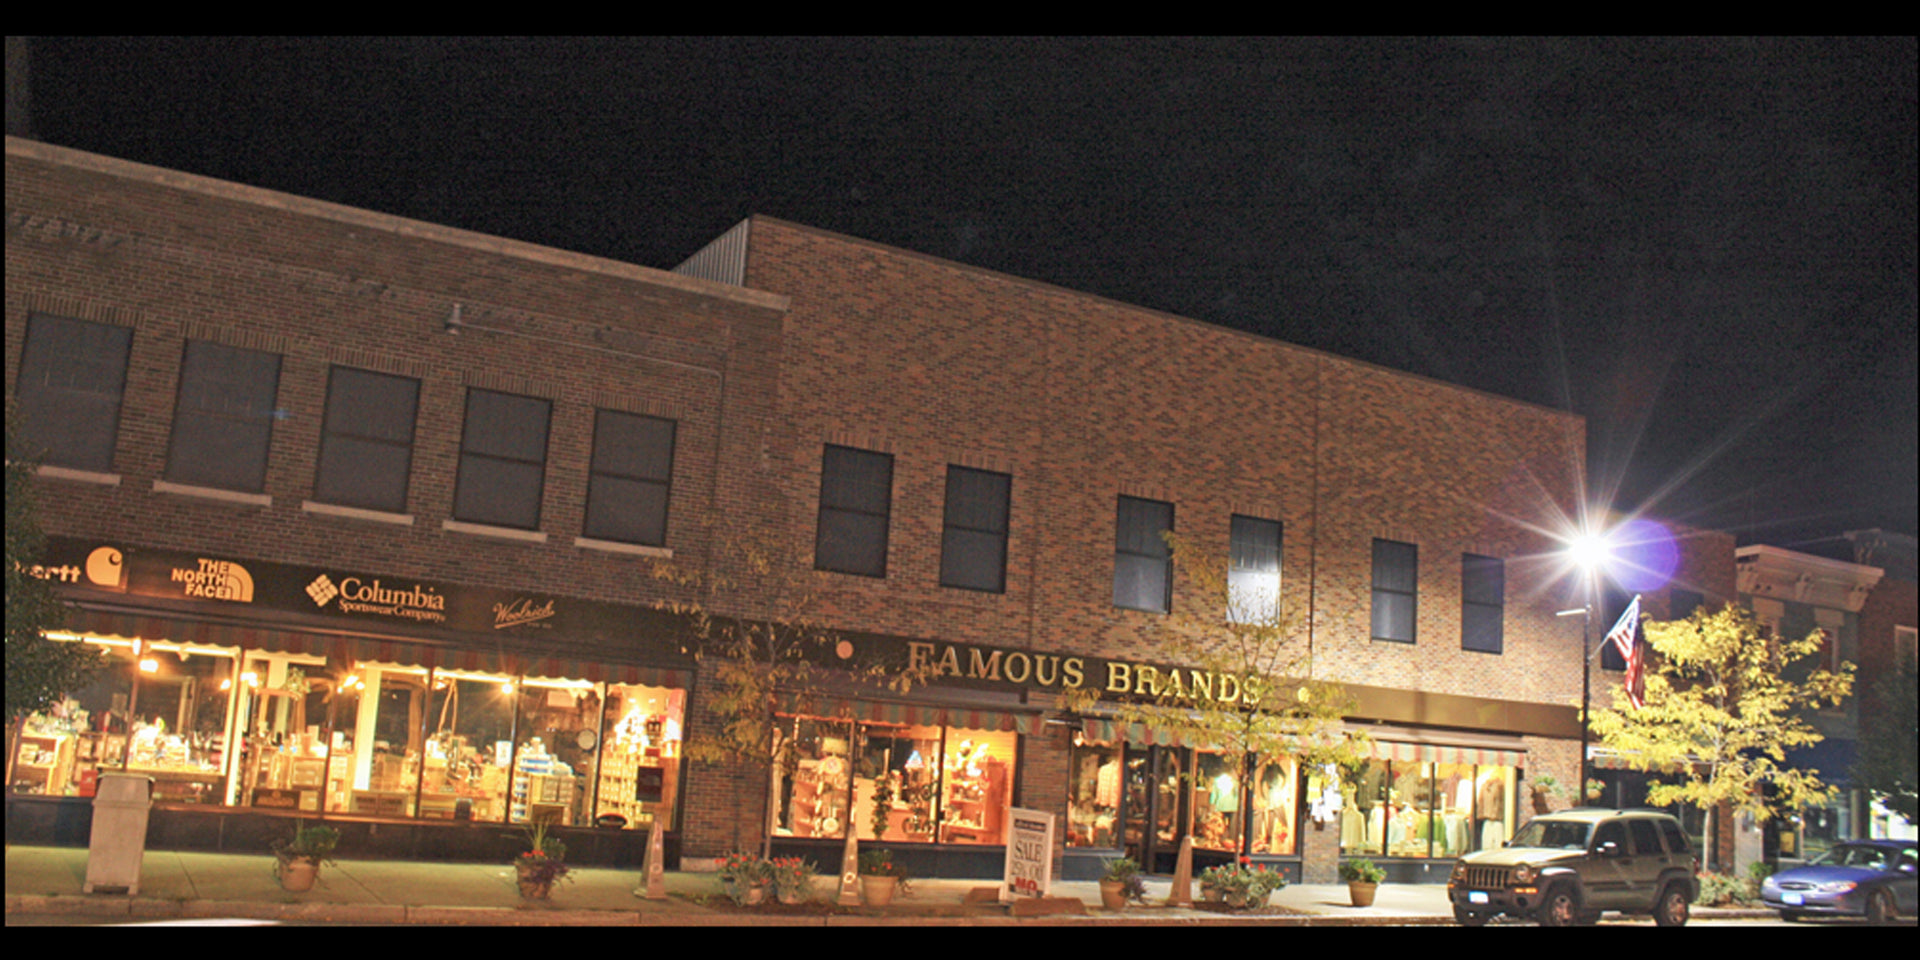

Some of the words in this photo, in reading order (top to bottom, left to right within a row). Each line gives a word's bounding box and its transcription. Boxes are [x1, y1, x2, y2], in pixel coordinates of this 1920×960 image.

[197, 557, 229, 574] THE
[171, 567, 226, 586] NORTH
[184, 583, 227, 599] FACE
[340, 577, 444, 610] Columbia
[907, 641, 1084, 689] FAMOUS
[1106, 662, 1261, 705] BRANDS
[1014, 840, 1043, 863] SALE
